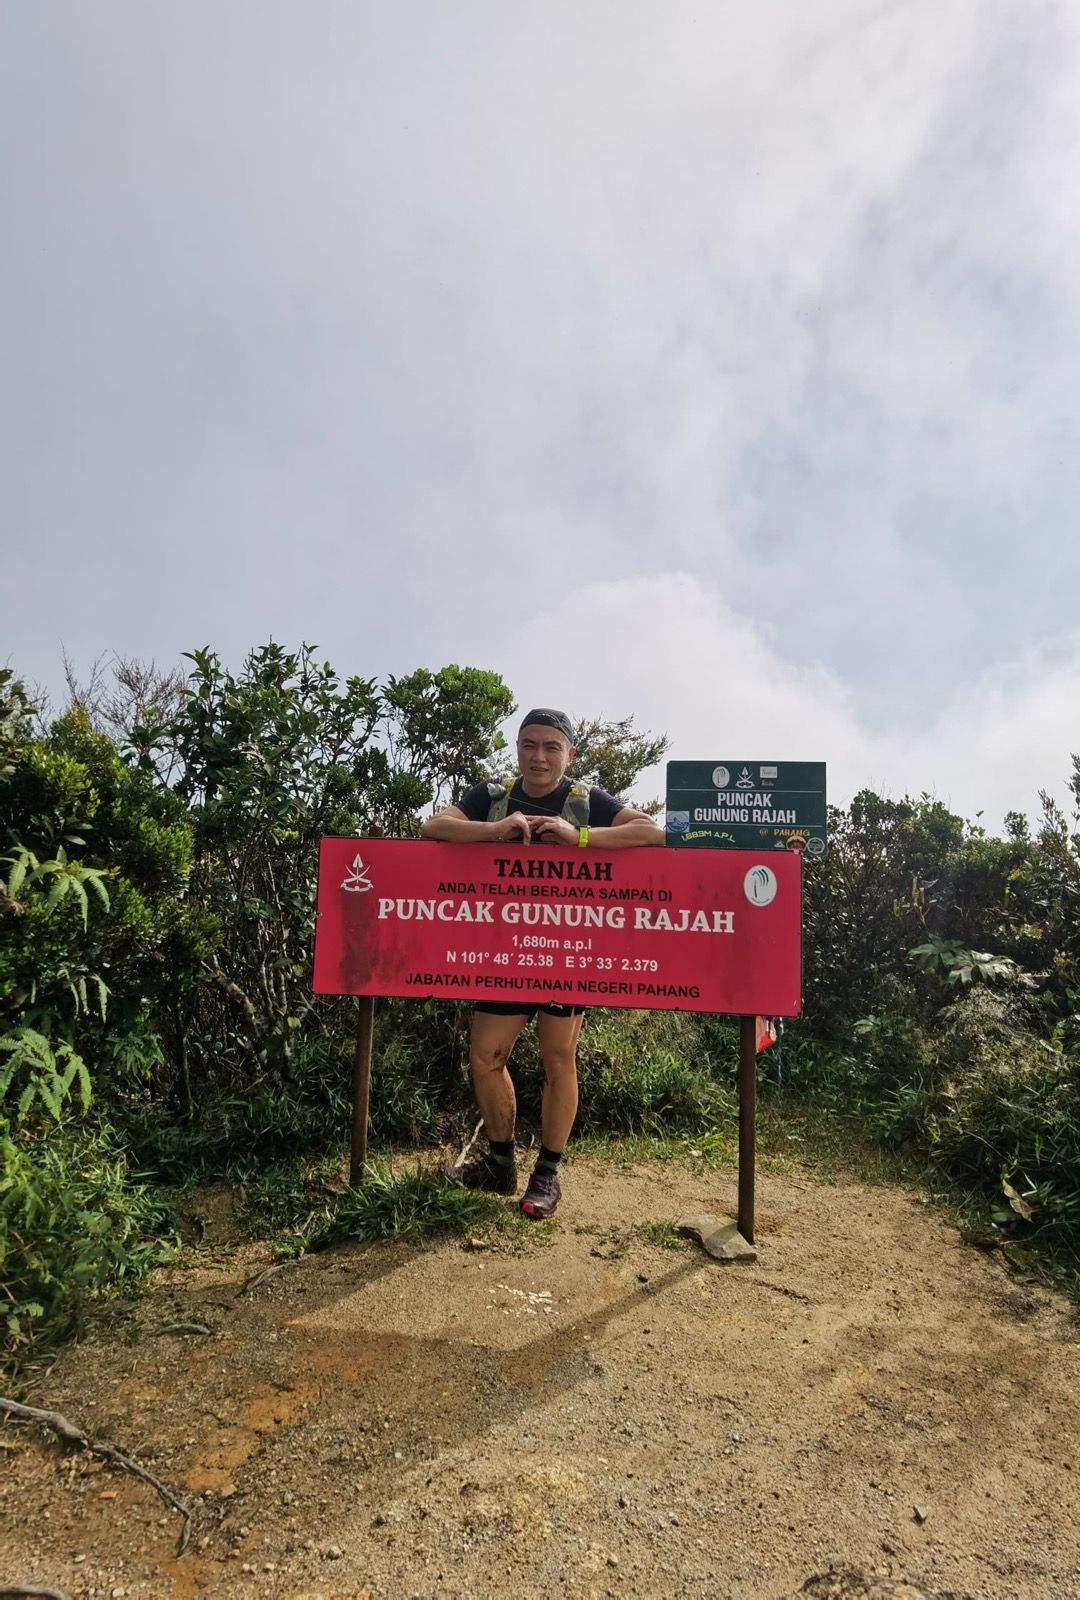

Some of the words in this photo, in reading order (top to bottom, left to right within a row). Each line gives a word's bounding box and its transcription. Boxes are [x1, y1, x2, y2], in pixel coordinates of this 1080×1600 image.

[717, 792, 773, 807] PUNCAK
[694, 807, 749, 822] GUNUNG
[752, 809, 796, 824] RAJAH
[494, 859, 613, 881] TAHNIAH
[437, 882, 477, 894] ANDA
[480, 883, 526, 896] TELAH
[530, 885, 595, 899] BERJAYA
[599, 888, 653, 902] SAMPAI
[658, 890, 672, 902] DI
[377, 898, 495, 923] PUNCAK
[501, 902, 626, 929] GUNUNG
[634, 907, 735, 933] RAJAH
[511, 935, 559, 949] 1,680m
[563, 938, 592, 952] a.p.l
[446, 951, 456, 963] N
[517, 954, 554, 967] 25.38
[565, 956, 575, 968] E
[621, 959, 658, 972] 2.379
[405, 972, 470, 987] JABATAN
[475, 976, 573, 992] PERHUTANAN
[577, 980, 633, 995] NEGERI
[637, 983, 700, 998] PAHANG
